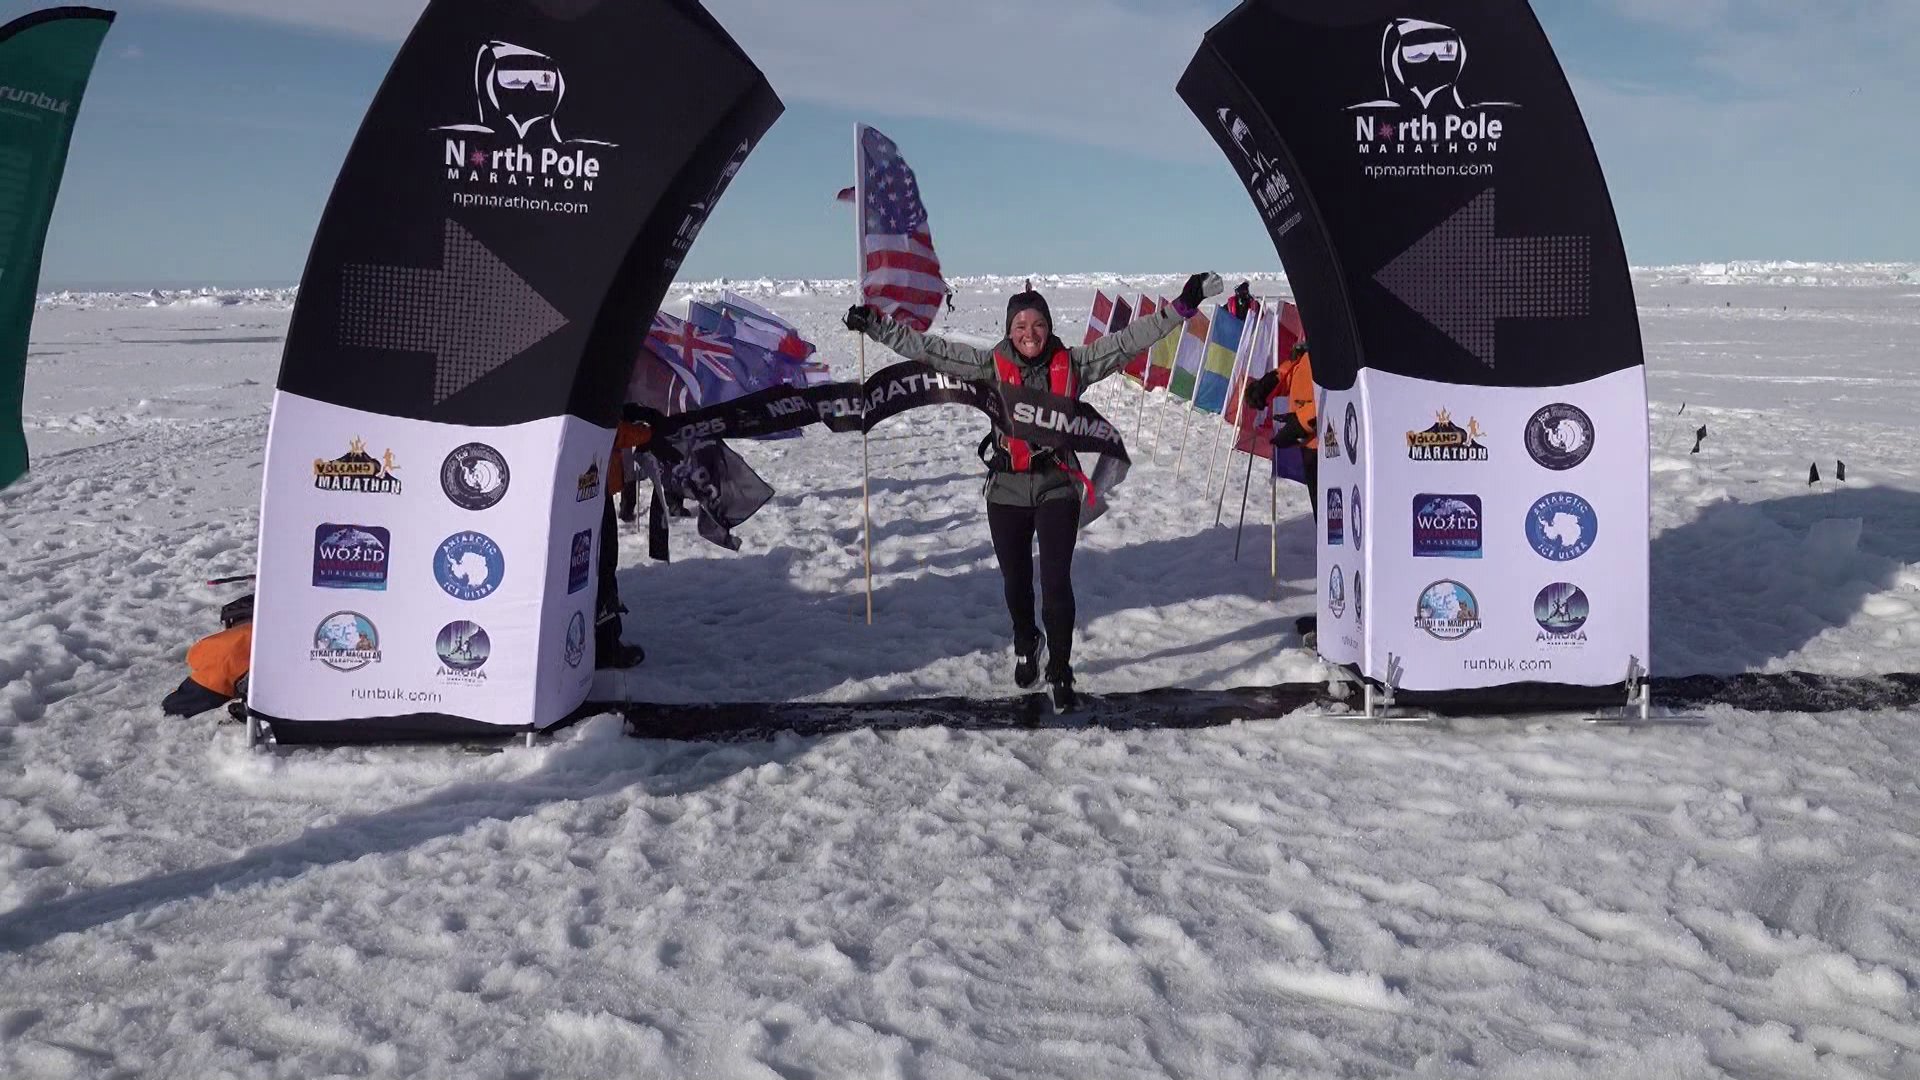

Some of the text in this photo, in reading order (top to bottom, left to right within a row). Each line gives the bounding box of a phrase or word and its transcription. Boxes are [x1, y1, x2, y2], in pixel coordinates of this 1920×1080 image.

[0, 86, 70, 114] runbuk
[1445, 112, 1503, 140] Pole
[1358, 141, 1498, 154] MARATHON
[541, 147, 600, 178] Pole
[1364, 163, 1493, 179] npmarathon.com
[447, 168, 594, 192] MARATHON
[453, 191, 589, 214] npmarathon.com
[1408, 432, 1458, 445] VOLCANO
[1411, 445, 1487, 460] MARATHON
[316, 462, 371, 473] VOLCANO
[318, 475, 400, 494] MARATHON
[1535, 630, 1588, 642] AURORA
[1463, 657, 1552, 671] runbuk.com
[436, 666, 487, 679] AURORA
[351, 687, 441, 703] runbuk.com
